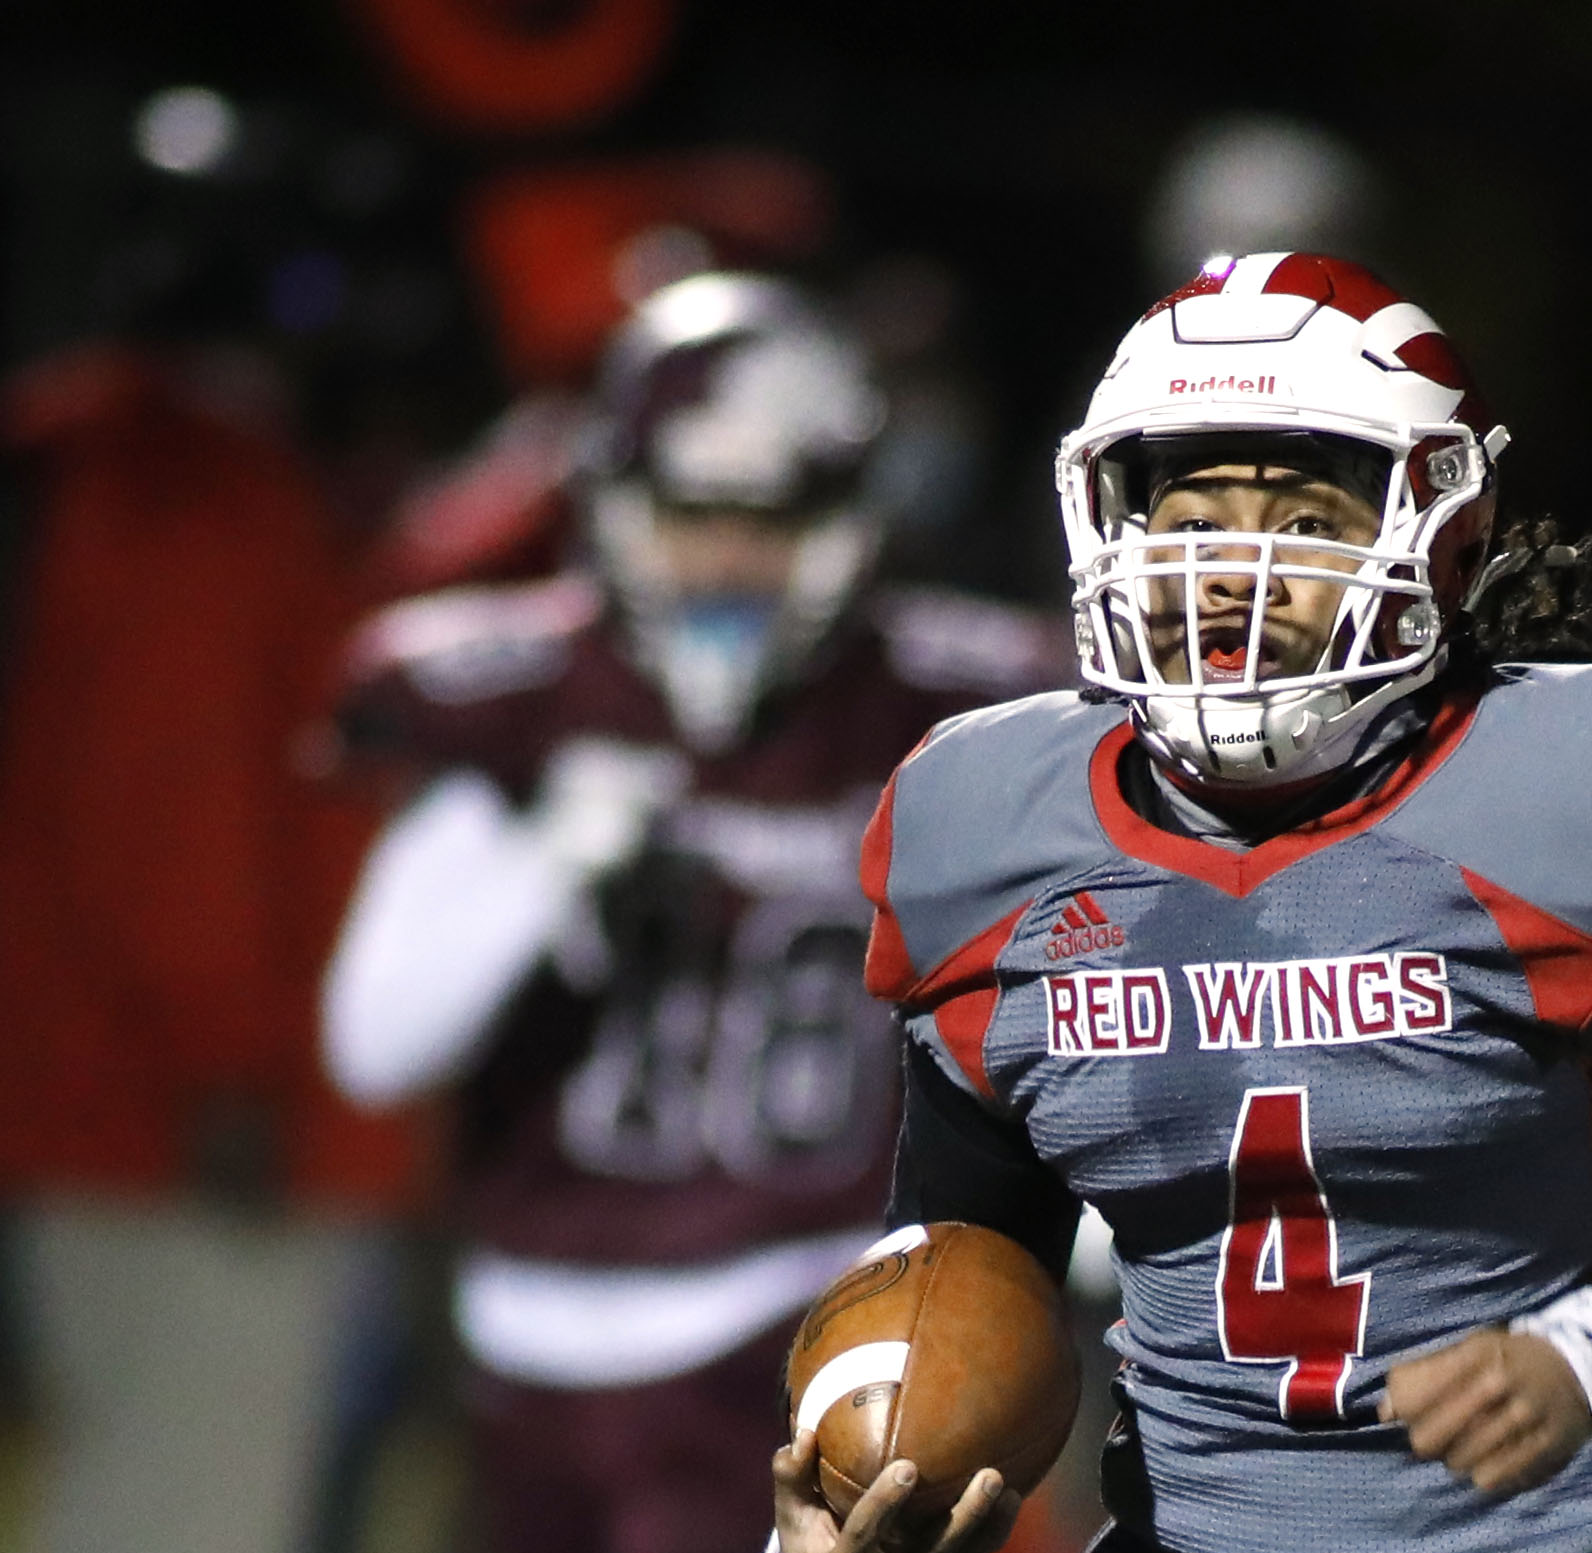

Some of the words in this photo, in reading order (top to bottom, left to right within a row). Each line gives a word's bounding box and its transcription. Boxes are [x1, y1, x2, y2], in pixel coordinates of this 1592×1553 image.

[1169, 375, 1276, 395] Riddell
[1210, 729, 1266, 745] Riddell
[1045, 924, 1126, 962] adidas
[1042, 967, 1172, 1057] RED
[1182, 951, 1452, 1050] WINGS
[1215, 1085, 1371, 1420] 4
